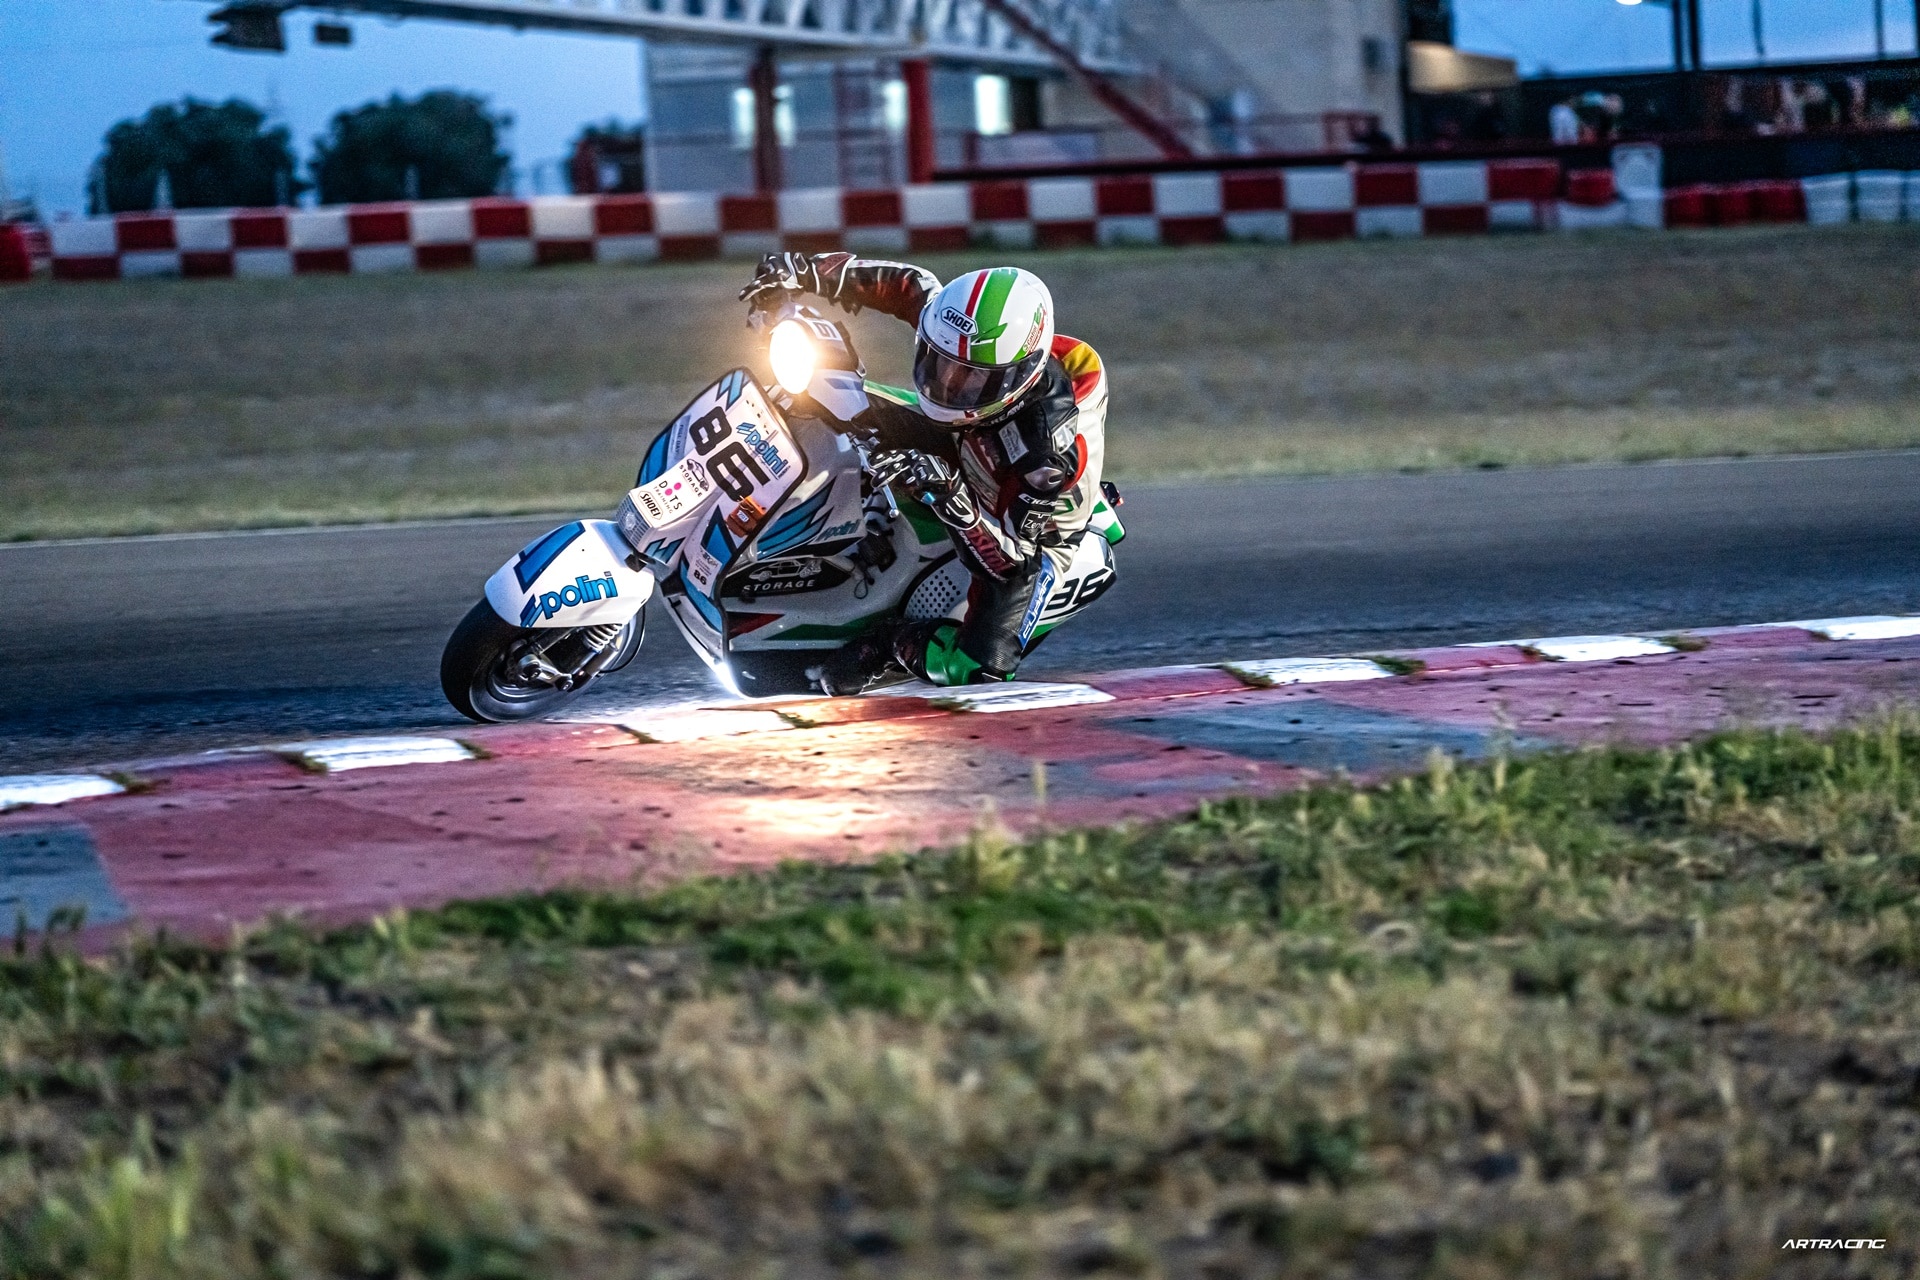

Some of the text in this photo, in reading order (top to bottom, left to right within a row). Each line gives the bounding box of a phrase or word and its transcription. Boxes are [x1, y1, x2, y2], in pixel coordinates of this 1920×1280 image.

[943, 310, 973, 332] SHOEI
[689, 406, 770, 502] 86
[745, 430, 788, 474] polini
[679, 464, 703, 497] STORAGE
[640, 493, 661, 516] SHOEI
[694, 569, 707, 585] 86
[743, 579, 815, 592] STORAGE
[539, 571, 618, 620] polini
